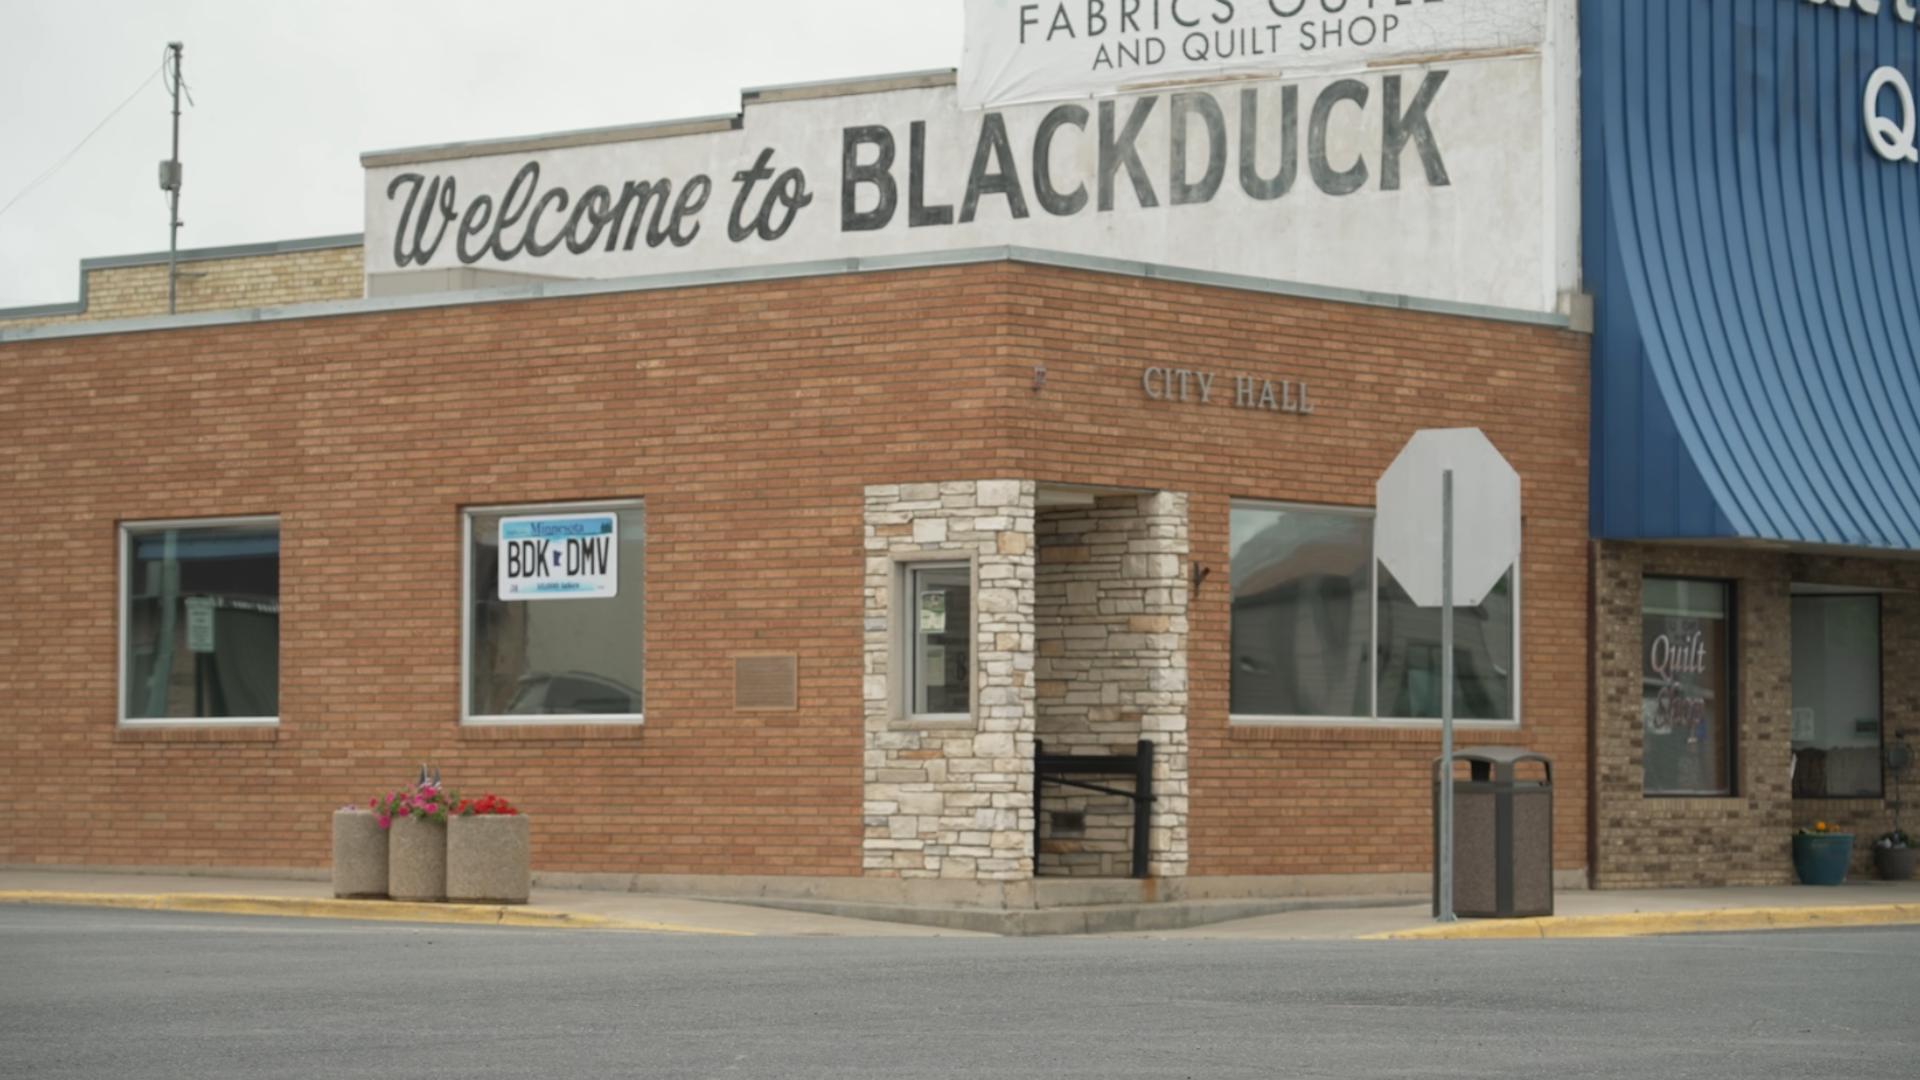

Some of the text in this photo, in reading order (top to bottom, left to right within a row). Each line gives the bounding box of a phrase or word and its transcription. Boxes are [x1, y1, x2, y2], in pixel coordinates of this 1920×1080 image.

[1020, 0, 1235, 44] FABRICS
[1092, 14, 1399, 71] AND QUILT SHOP
[386, 69, 1452, 268] Welcome to BLACKDUCK
[1143, 366, 1315, 414] CITY HALL
[507, 536, 610, 579] BDK DMV
[1651, 630, 1706, 681] Quilt
